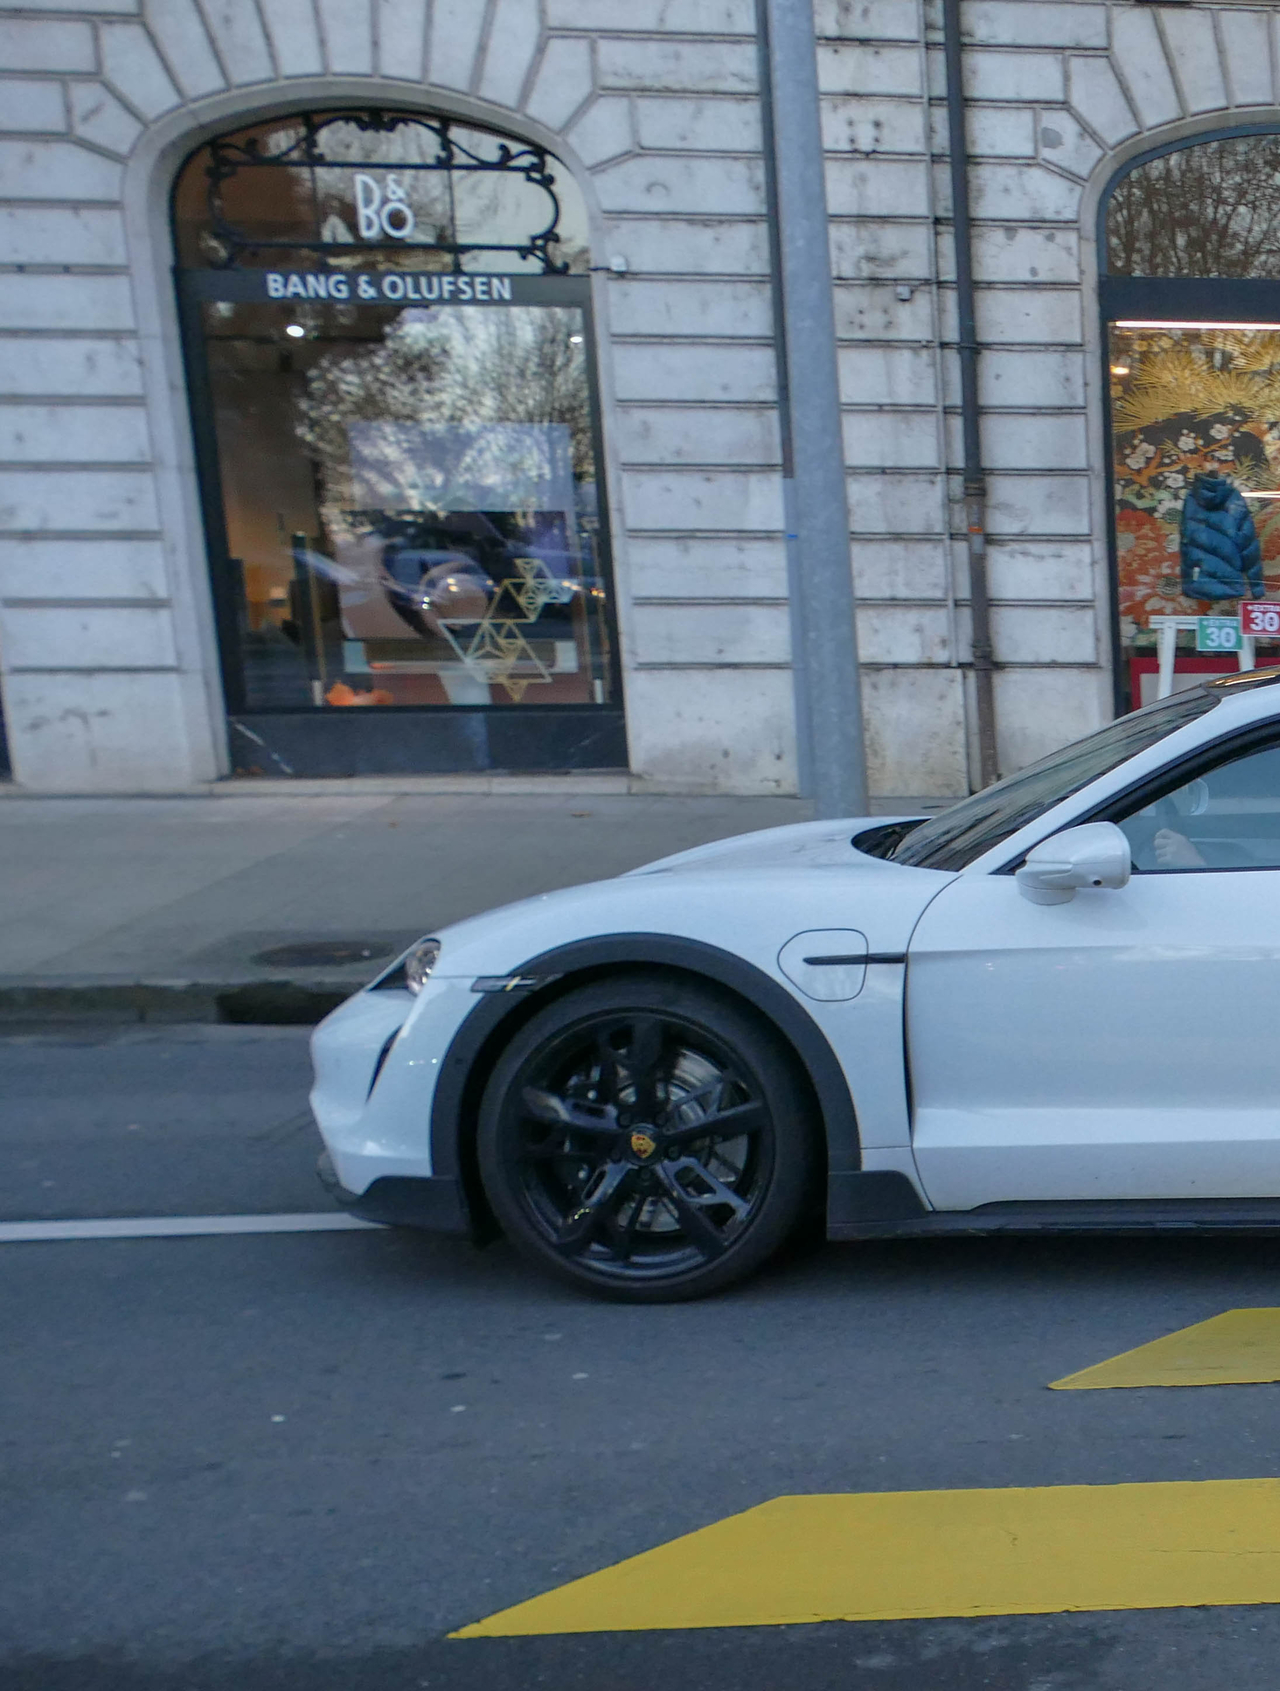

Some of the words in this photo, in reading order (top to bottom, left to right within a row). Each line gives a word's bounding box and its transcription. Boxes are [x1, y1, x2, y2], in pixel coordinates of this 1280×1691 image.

[266, 273, 350, 299] BANG
[357, 274, 377, 300] &
[381, 274, 512, 301] OLUFSEN
[1249, 611, 1280, 631] 30
[1205, 627, 1237, 647] 30
